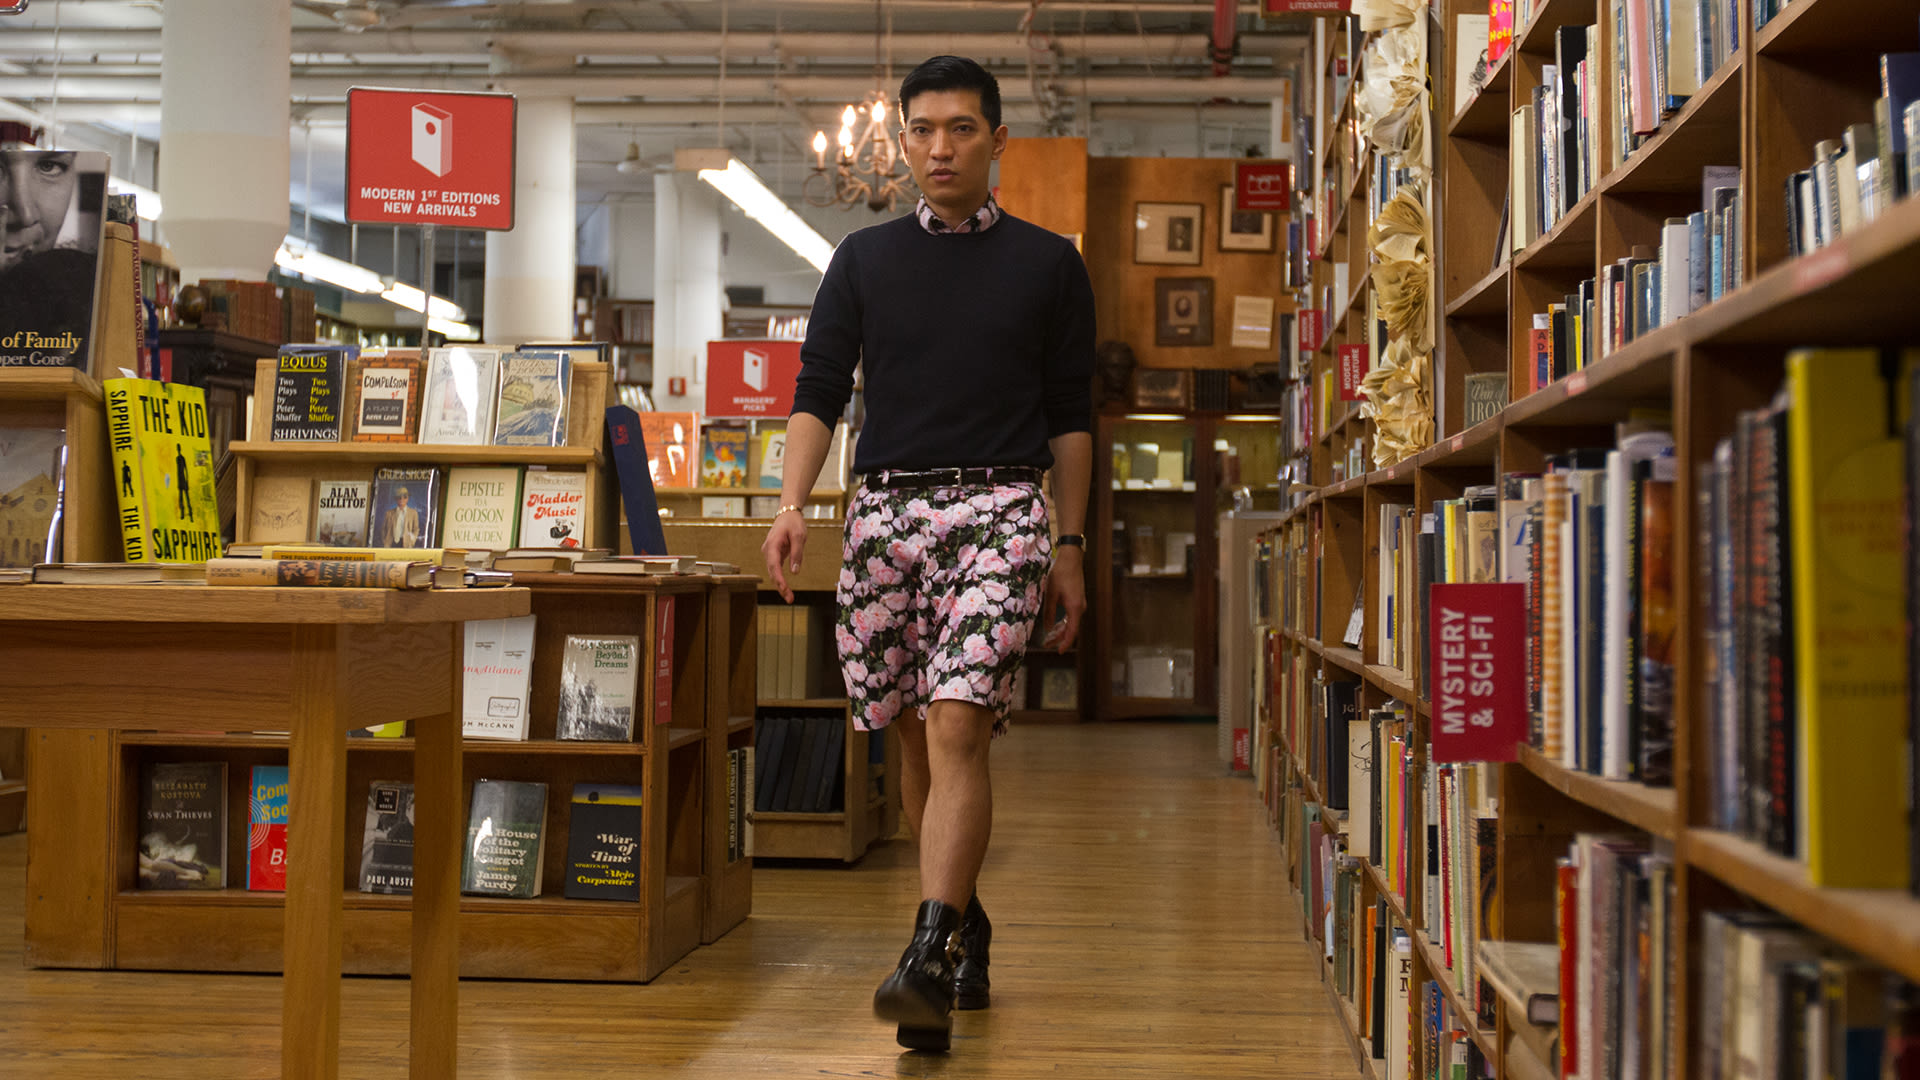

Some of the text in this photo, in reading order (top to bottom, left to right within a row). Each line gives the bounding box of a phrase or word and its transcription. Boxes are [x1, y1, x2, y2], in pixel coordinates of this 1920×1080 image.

[1289, 1, 1339, 10] LITERATURE
[361, 187, 501, 206] MODERN 1ST EDITIONS
[383, 202, 477, 217] NEW ARRIVALS
[1, 331, 83, 354] of Family
[29, 351, 66, 365] Gore
[280, 355, 327, 369] EQUUS
[1343, 354, 1351, 390] MODERN
[279, 377, 294, 386] Two
[312, 377, 327, 386] Two
[278, 386, 297, 396] Plays
[311, 386, 330, 396] Plays
[277, 396, 287, 405] by
[310, 396, 319, 404] by
[276, 405, 295, 413] Peter
[309, 405, 328, 413] Peter
[743, 404, 766, 412] PICKS
[1471, 401, 1506, 422] IRON
[110, 390, 133, 452] SAPPHIRE
[138, 395, 206, 438] THE KID
[275, 413, 302, 422] Shaffer
[308, 413, 335, 422] Shaffer
[273, 428, 338, 440] SHRIVINGS
[330, 487, 358, 499] ALAN
[460, 481, 505, 497] EPISTLE
[320, 498, 366, 509] SILLITOE
[527, 492, 583, 508] Madder
[454, 508, 504, 523] GODSON
[533, 506, 577, 520] Music
[122, 505, 143, 561] THE KID
[474, 530, 503, 543] AUDEN
[152, 528, 218, 561] SAPPHIRE
[595, 651, 629, 660] Beyond
[594, 660, 629, 668] Dreams
[1441, 607, 1465, 734] MYSTERY
[1470, 616, 1494, 728] & SCI-FI
[155, 783, 207, 791] ELIZABETH
[160, 791, 201, 800] KOSTOVA
[147, 810, 213, 819] SWAN THIEVES
[495, 828, 538, 839] House
[596, 833, 633, 844] War
[498, 837, 520, 847] the
[618, 843, 637, 856] of
[591, 851, 632, 863] Time
[366, 874, 386, 884] PAUL
[475, 871, 518, 881] James
[605, 869, 635, 880] Alejo
[474, 879, 517, 892] Purdy
[576, 875, 635, 887] Carpentier
